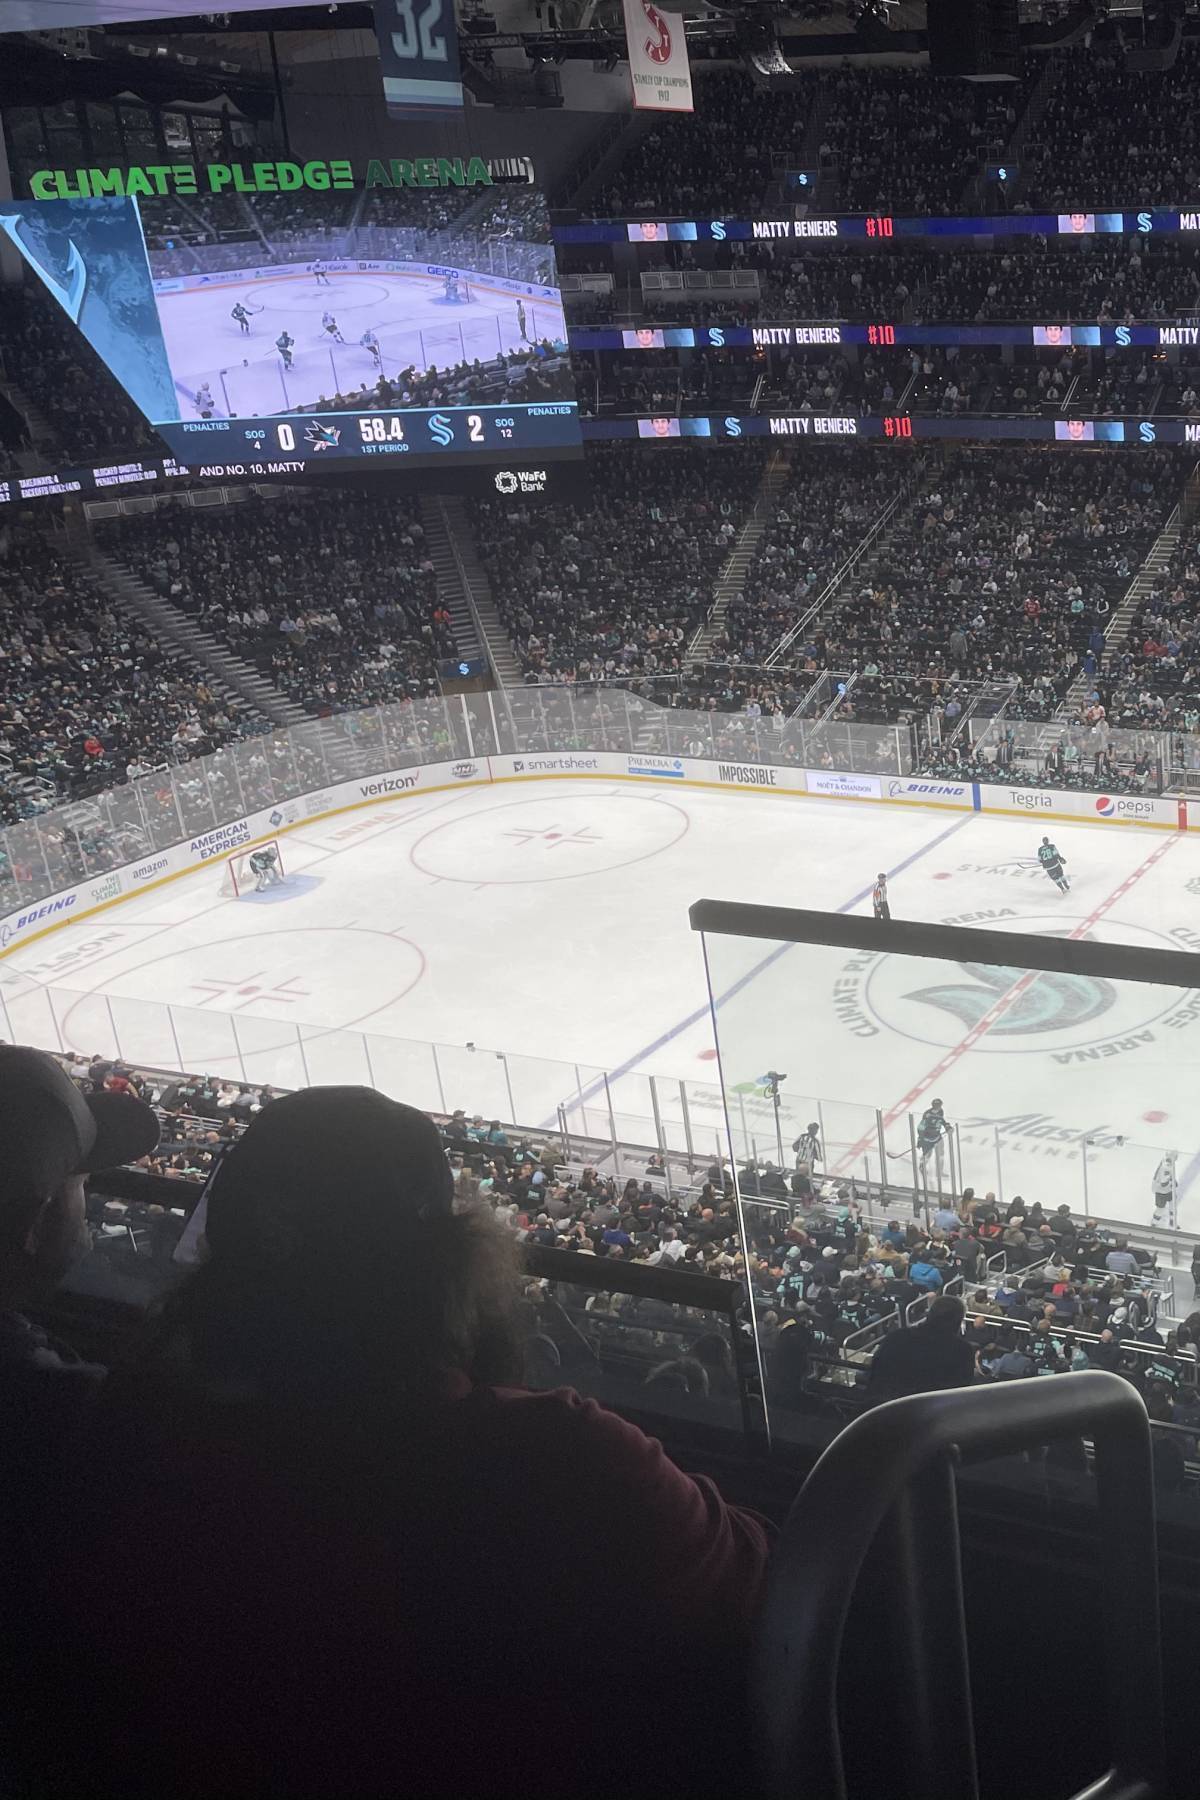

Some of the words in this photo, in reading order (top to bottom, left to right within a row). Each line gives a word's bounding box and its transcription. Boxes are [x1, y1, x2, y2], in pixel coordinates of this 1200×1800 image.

[29, 165, 198, 200] CLIMATE
[207, 160, 354, 192] PLEDGE
[365, 157, 493, 189] ARENA
[753, 220, 790, 238] MATTY
[794, 220, 837, 238] BENIERS
[866, 217, 893, 238] #10
[427, 265, 458, 279] GEICO
[753, 327, 790, 346] MATTY
[795, 327, 840, 345] BENIERS
[868, 325, 895, 345] #10
[1159, 327, 1199, 344] MATTY
[527, 406, 571, 416] PENALTIES
[183, 422, 230, 432] PENALTIES
[359, 416, 404, 442] 58.4
[467, 415, 485, 442] 2
[495, 418, 514, 427] SOG
[770, 417, 809, 435] MATTY
[813, 416, 856, 435] BENIERS
[884, 416, 912, 437] #10
[244, 430, 265, 439] SOG
[277, 423, 295, 451] 0
[500, 429, 513, 438] 12
[254, 440, 261, 450] 4
[361, 445, 377, 453] 1ST
[379, 444, 409, 453] PERIOD
[200, 465, 224, 477] AND
[226, 464, 247, 476] NO.
[250, 463, 266, 475] 10,
[268, 462, 305, 474] MATTY
[517, 470, 547, 482] WaFd
[521, 482, 545, 492] Bank
[528, 755, 598, 770] smartsheet
[718, 765, 776, 786] IMPOSSIBLE
[359, 775, 415, 798] verizon
[907, 783, 966, 796] BOEING
[1010, 791, 1052, 808] Tegria
[1117, 800, 1154, 813] pepsi
[190, 821, 248, 852] AMERICAN
[200, 832, 251, 859] EXPRESS
[133, 858, 168, 878] amazon
[17, 893, 77, 929] BOEING
[940, 907, 1019, 925] RENA
[833, 977, 880, 1038] CLIMATE
[1049, 1029, 1156, 1065] ARENA
[960, 1134, 1098, 1163] AIRLINES
